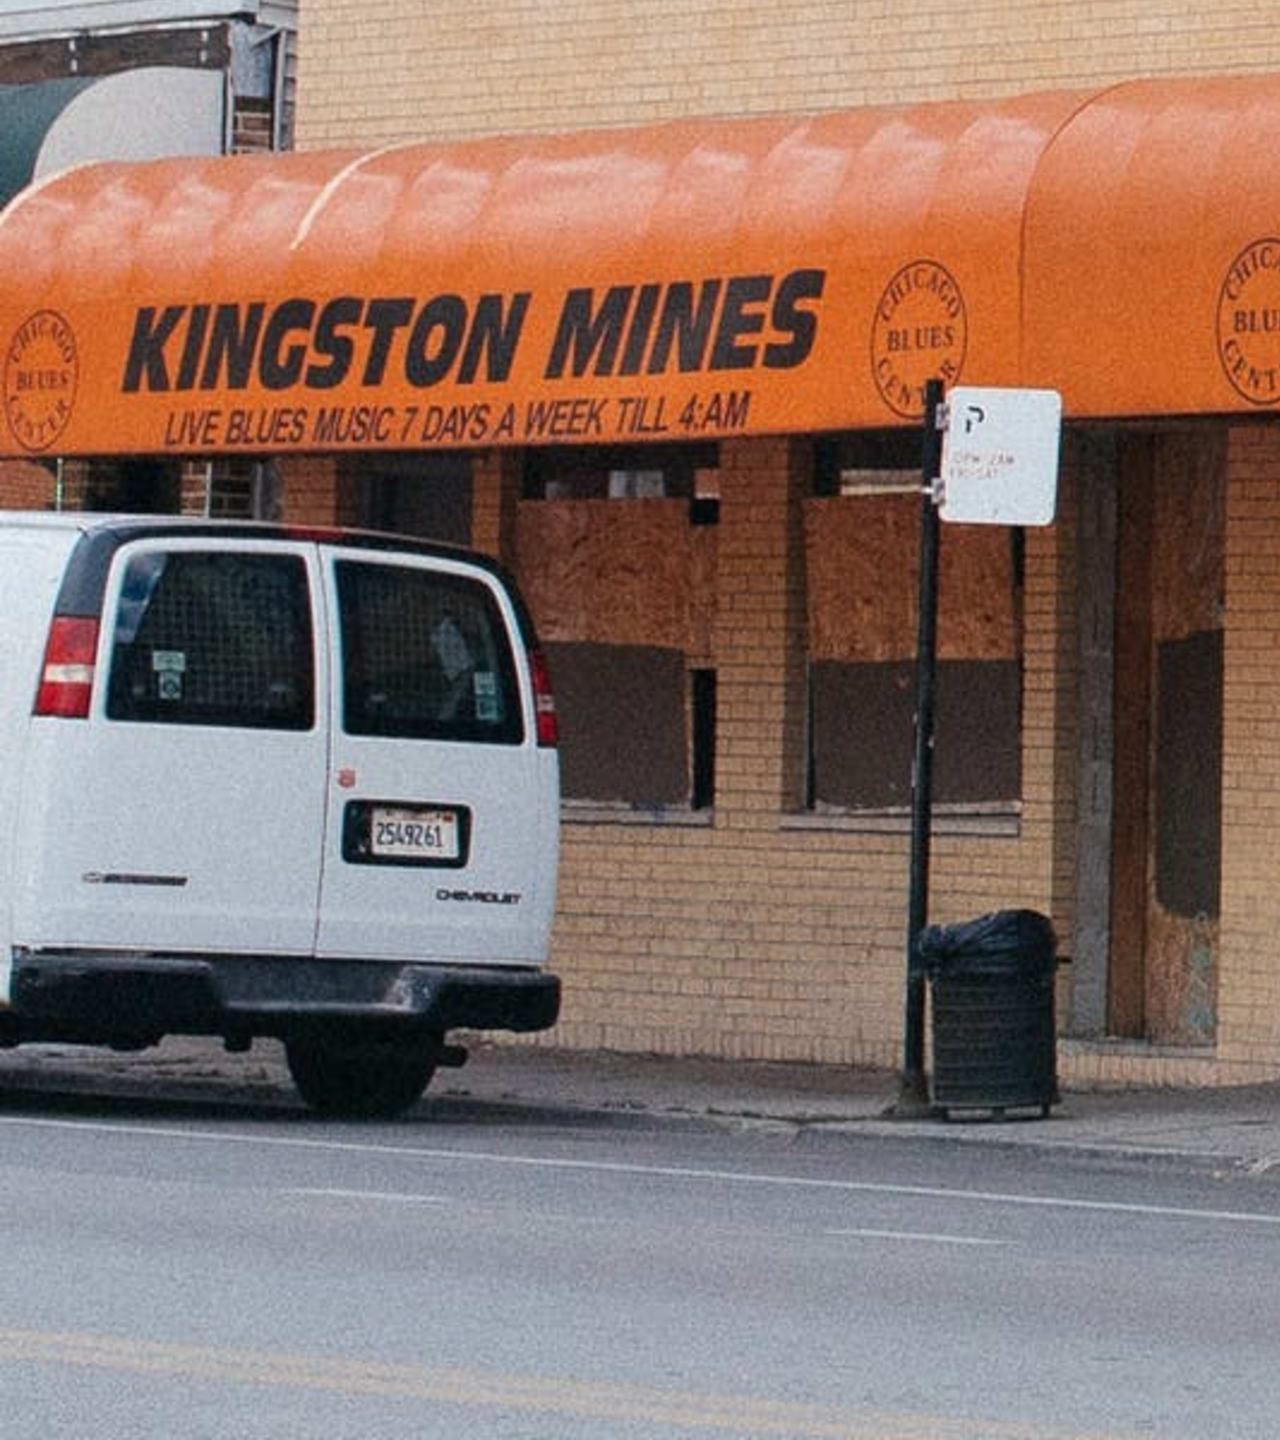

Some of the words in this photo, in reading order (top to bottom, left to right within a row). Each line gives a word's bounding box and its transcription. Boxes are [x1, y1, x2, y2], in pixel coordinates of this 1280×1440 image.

[880, 267, 961, 322] CHICAGO
[121, 292, 532, 393] KINGSTON
[544, 269, 826, 379] MINES
[887, 326, 955, 352] BLUES
[16, 368, 72, 391] BLUES
[878, 357, 957, 407] CENTR
[164, 409, 222, 446] LIVE
[225, 406, 306, 445] BLUES
[313, 406, 394, 443] MUSIC
[401, 406, 418, 439] 7
[422, 404, 489, 442] DAYS
[494, 402, 515, 437] A
[524, 397, 608, 436] WEEK
[617, 395, 669, 432] TILL
[679, 391, 751, 429] 4:AM
